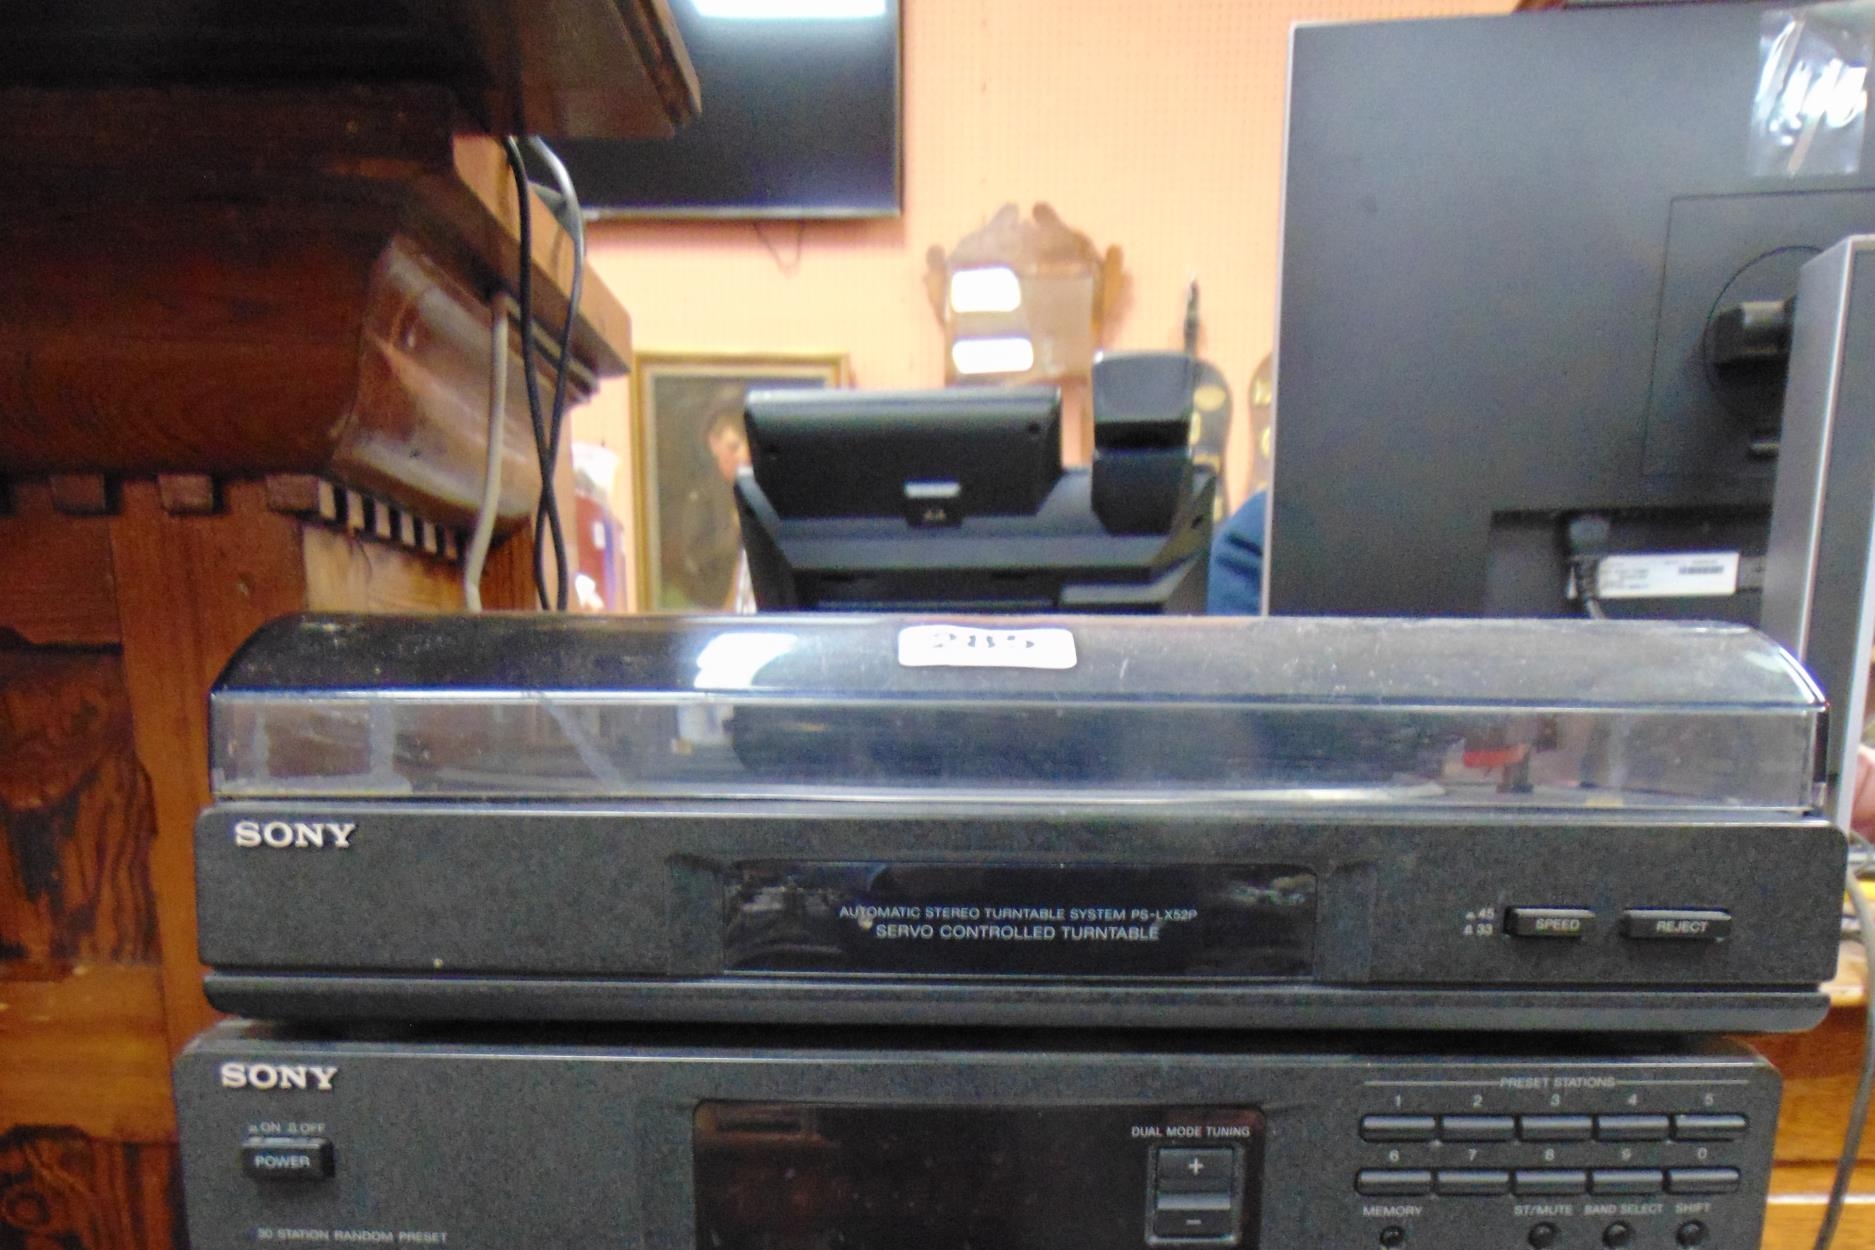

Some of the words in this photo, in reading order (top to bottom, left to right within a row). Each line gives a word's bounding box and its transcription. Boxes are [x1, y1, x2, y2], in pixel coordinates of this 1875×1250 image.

[234, 821, 356, 848] SONY
[839, 905, 921, 919] AUTOMATIC
[925, 906, 980, 919] STEREO
[984, 907, 1065, 920] TURNTABLE
[1069, 908, 1126, 921] SYSTEM
[1478, 908, 1495, 919] 45
[1535, 918, 1580, 931] SPEED
[1655, 920, 1709, 933] REJECT
[875, 923, 934, 939] SERVO
[940, 924, 1056, 940] CONTROLLED
[1062, 925, 1160, 941] TURNTABLE
[220, 1061, 338, 1090] SONY
[1500, 1077, 1548, 1088] PRESET
[1553, 1076, 1616, 1088] STATIONS
[1472, 1094, 1483, 1107] 2
[1551, 1093, 1560, 1106] 3
[1628, 1093, 1638, 1106] 4
[260, 1121, 280, 1132] ON
[1131, 1126, 1162, 1138] DUAL
[1166, 1126, 1202, 1137] MODE
[1206, 1126, 1250, 1137] TUNING
[1389, 1149, 1399, 1161] 6
[1469, 1149, 1478, 1161] 7
[1544, 1149, 1555, 1161] 8
[1621, 1148, 1631, 1161] 9
[1697, 1147, 1708, 1160] 0
[255, 1155, 311, 1169] POWER
[1362, 1205, 1423, 1216] MEMORY
[1584, 1204, 1617, 1216] BAND
[1620, 1203, 1664, 1215] SELECT
[1674, 1202, 1711, 1214] SHIFT
[278, 1228, 329, 1241] STATION
[334, 1230, 393, 1242] RANDOM
[399, 1231, 448, 1243] PRESET
